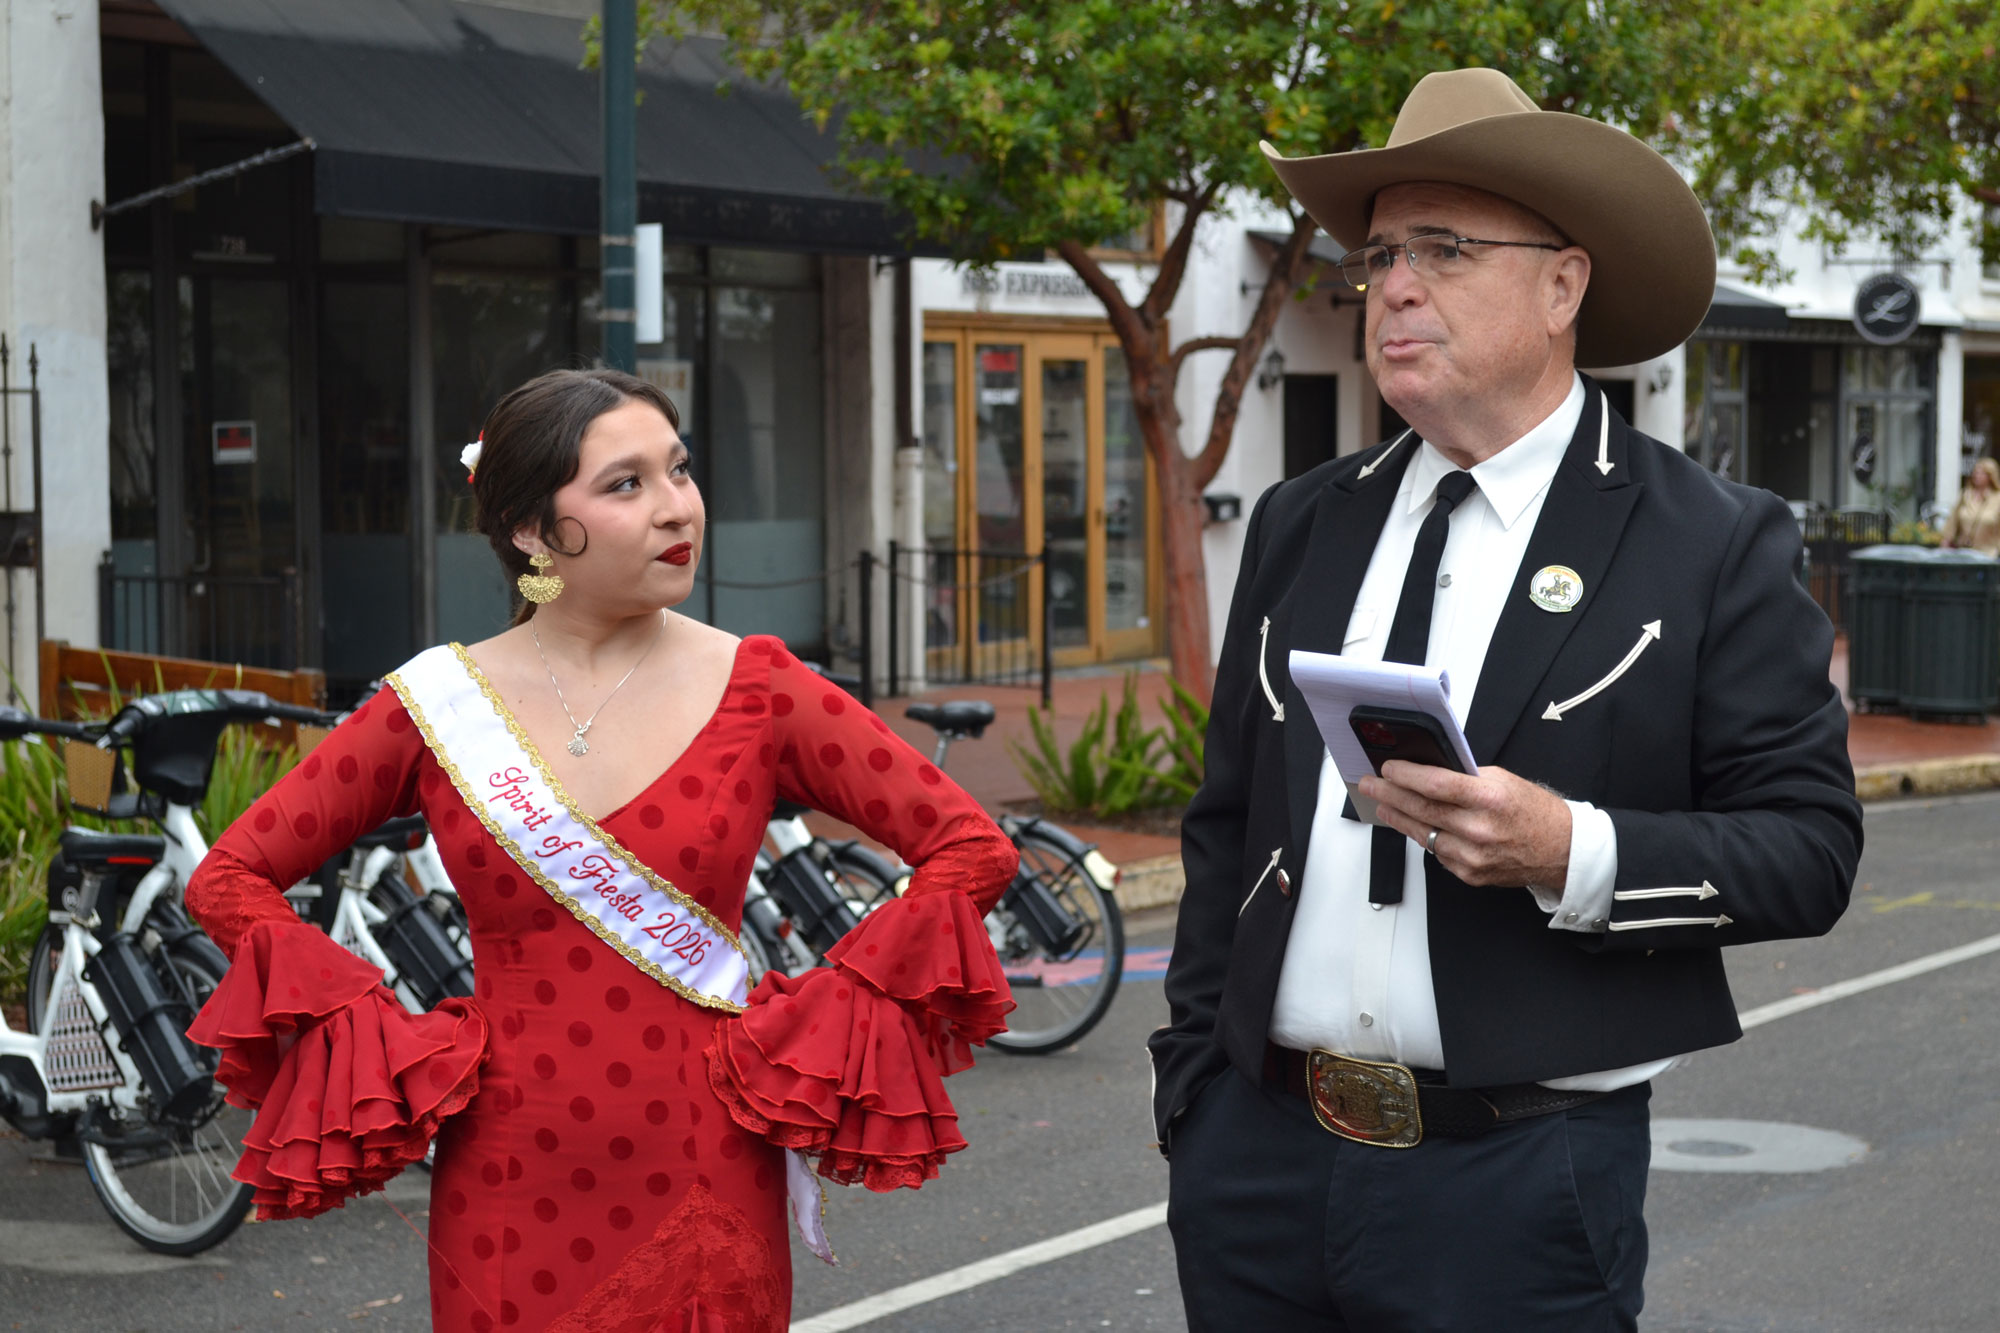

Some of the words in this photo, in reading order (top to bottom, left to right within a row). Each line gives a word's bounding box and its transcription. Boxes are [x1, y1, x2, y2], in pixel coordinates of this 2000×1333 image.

[489, 767, 552, 831] Spirit
[535, 835, 583, 857] of
[568, 855, 645, 922] Fiesta
[641, 912, 711, 966] 2026
